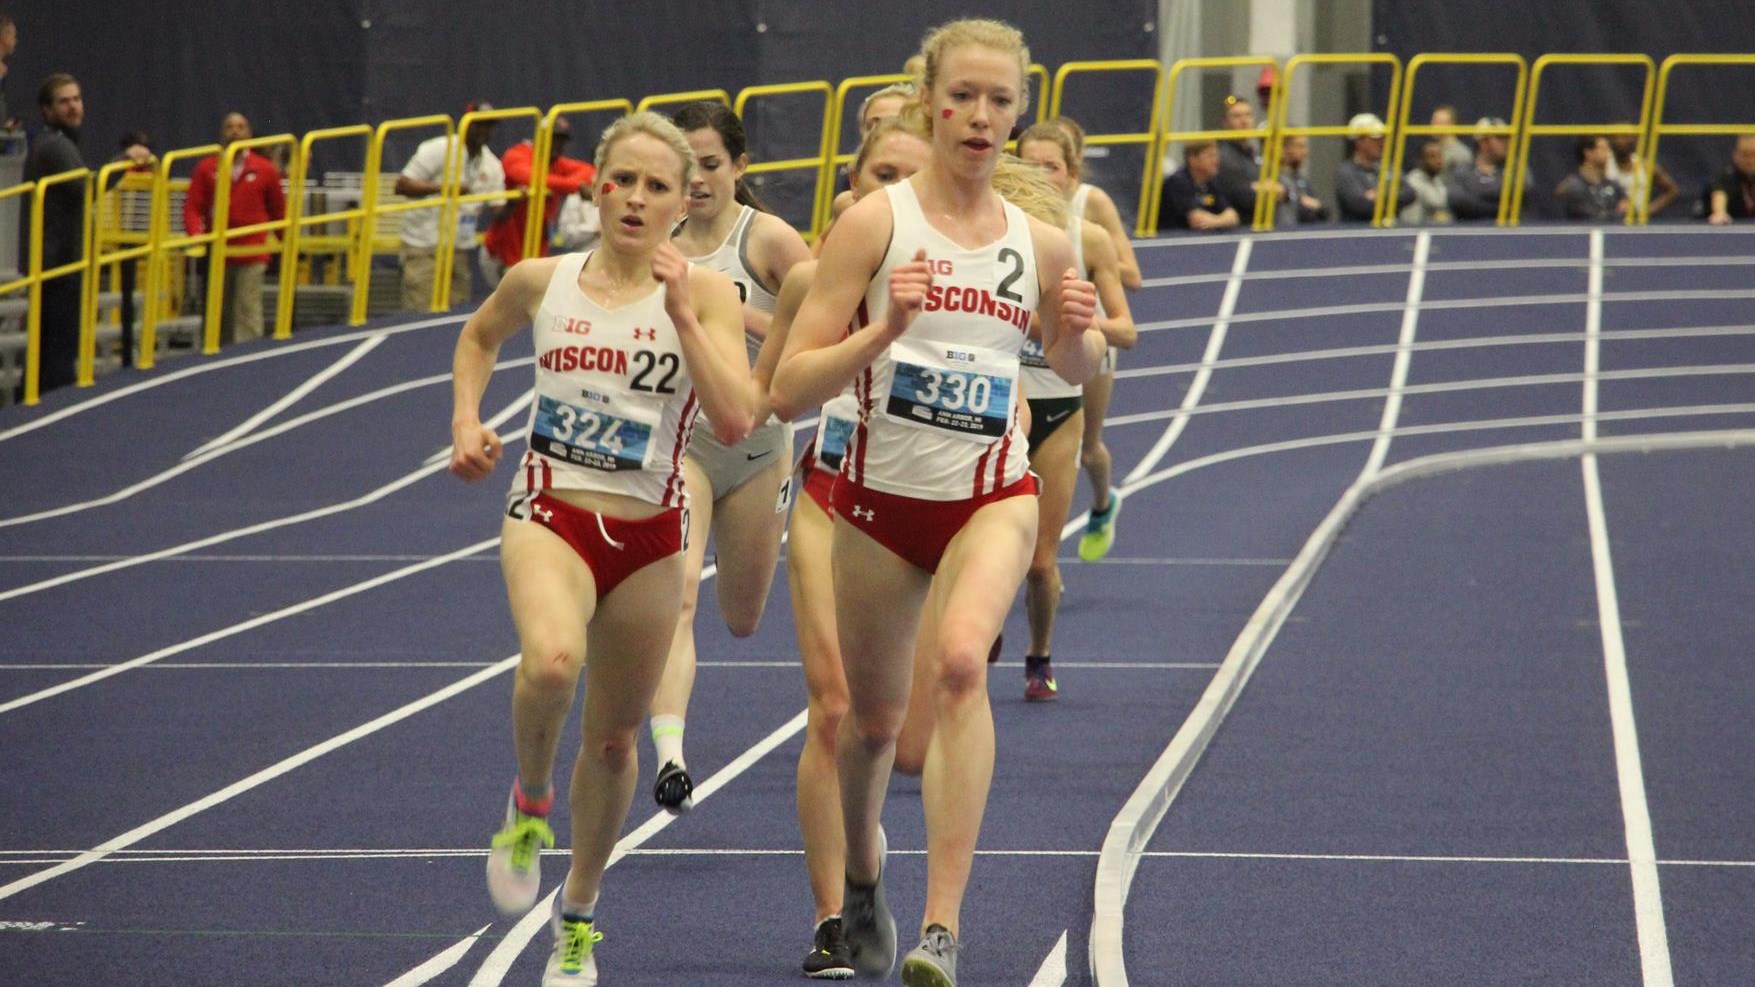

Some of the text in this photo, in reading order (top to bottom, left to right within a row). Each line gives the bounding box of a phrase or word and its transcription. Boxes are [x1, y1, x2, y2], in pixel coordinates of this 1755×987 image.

[996, 247, 1025, 304] 2
[924, 285, 1031, 335] SCONSIN
[629, 349, 680, 395] 22
[915, 367, 992, 414] 330
[552, 404, 624, 455] 324
